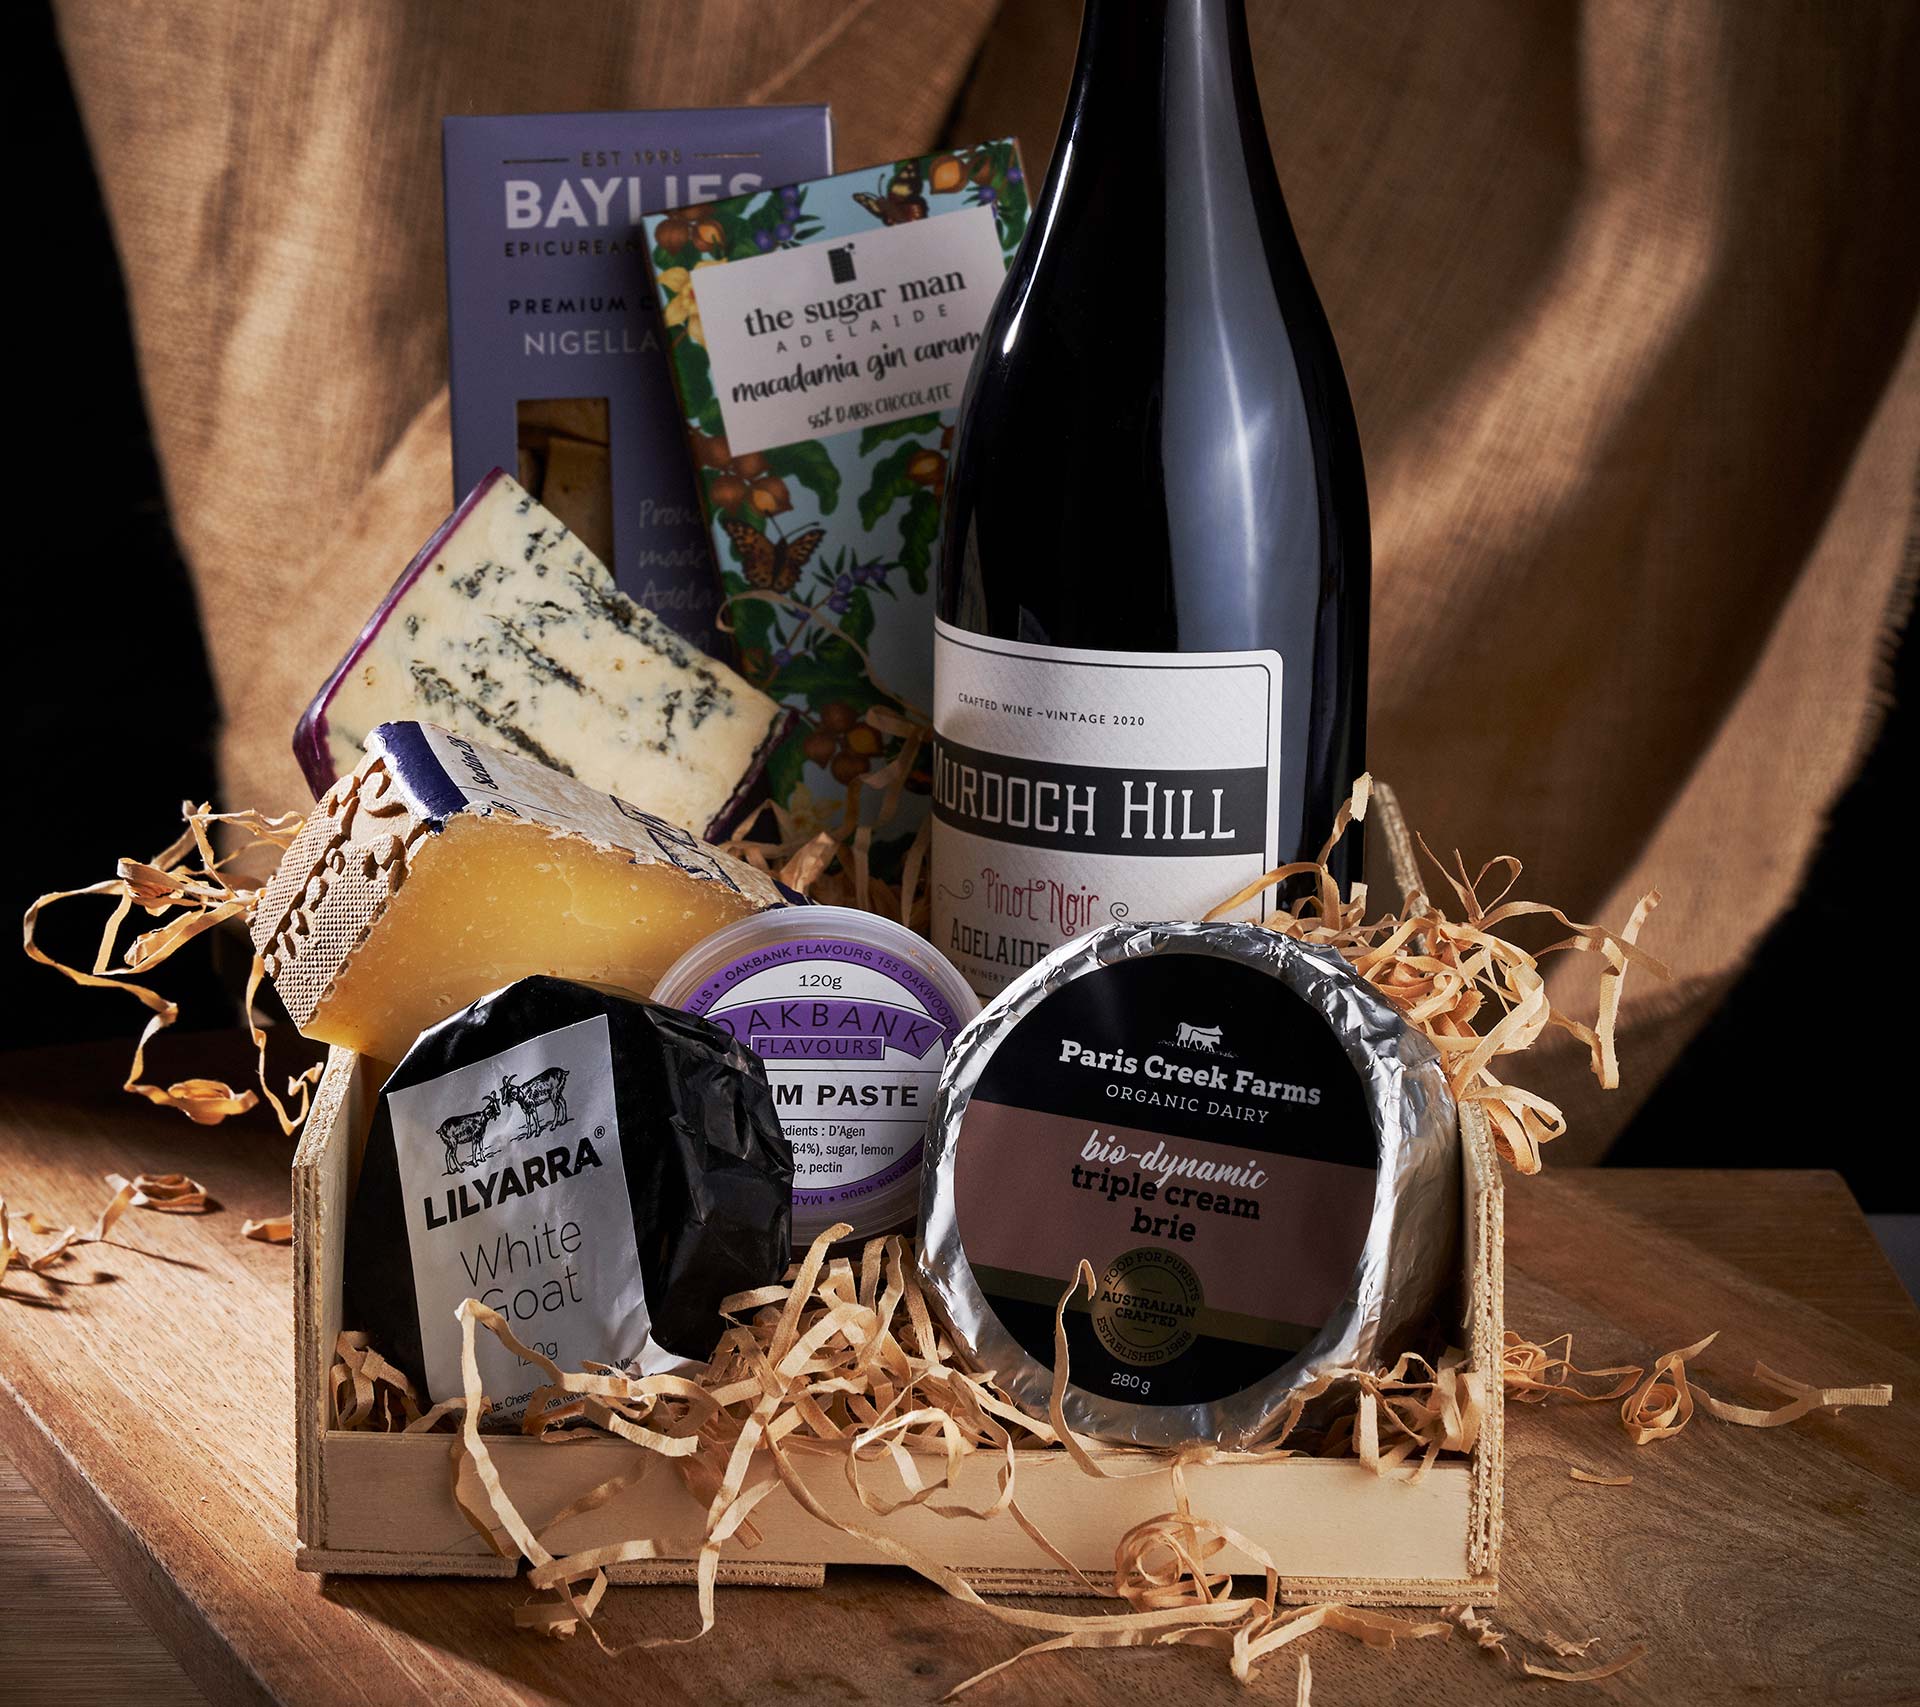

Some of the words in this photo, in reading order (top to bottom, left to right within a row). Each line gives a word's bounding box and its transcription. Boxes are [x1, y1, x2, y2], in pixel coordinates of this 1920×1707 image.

[582, 151, 620, 167] EST
[509, 297, 627, 315] PREMIUM
[744, 307, 793, 338] the
[804, 287, 887, 325] sugar
[898, 271, 967, 302] man
[525, 329, 660, 355] NIGELLA
[776, 304, 949, 353] ADELAIDE
[732, 354, 860, 403] macadamia
[867, 343, 908, 381] gin
[807, 407, 832, 429] 55%
[836, 399, 875, 424] DARK
[875, 383, 953, 414] CHOCOLATE
[958, 693, 997, 711] CRAFTED
[1002, 703, 1033, 717] WINE
[1113, 715, 1145, 726] 2020
[932, 741, 1097, 837] MURDOCH
[981, 867, 1046, 921] Pinot
[1048, 878, 1099, 936] Noir
[725, 947, 792, 980] OAKBANK
[797, 944, 873, 961] FLAVOURS
[878, 956, 900, 973] 155
[902, 970, 952, 1023] OAKWOOD
[798, 974, 842, 990] 120g
[757, 1039, 878, 1055] FLAVOURS
[1059, 1039, 1138, 1074] Paris
[1144, 1055, 1228, 1090] Creek
[1233, 1069, 1321, 1105] Farms
[769, 1085, 803, 1105] M
[817, 1085, 919, 1107] PASTE
[1106, 1084, 1199, 1112] ORGANIC
[1207, 1101, 1269, 1124] DAIRY
[826, 1145, 857, 1157] sugar,
[861, 1143, 894, 1155] lemon
[829, 1125, 865, 1139] D'Agen
[809, 1161, 843, 1175] pectin
[1080, 1129, 1269, 1189] bio-dynamic
[1071, 1164, 1158, 1202] triple
[1165, 1184, 1260, 1220] cream
[1130, 1207, 1196, 1243] brie
[460, 1222, 582, 1287] White
[1104, 1256, 1134, 1285] FOOD
[1137, 1251, 1162, 1262] FOR
[479, 1266, 582, 1322] Goat
[1100, 1291, 1196, 1319] AUSTRALIAN
[1115, 1307, 1177, 1328] CRAFTED
[1097, 1316, 1164, 1361] ESTABLISHED
